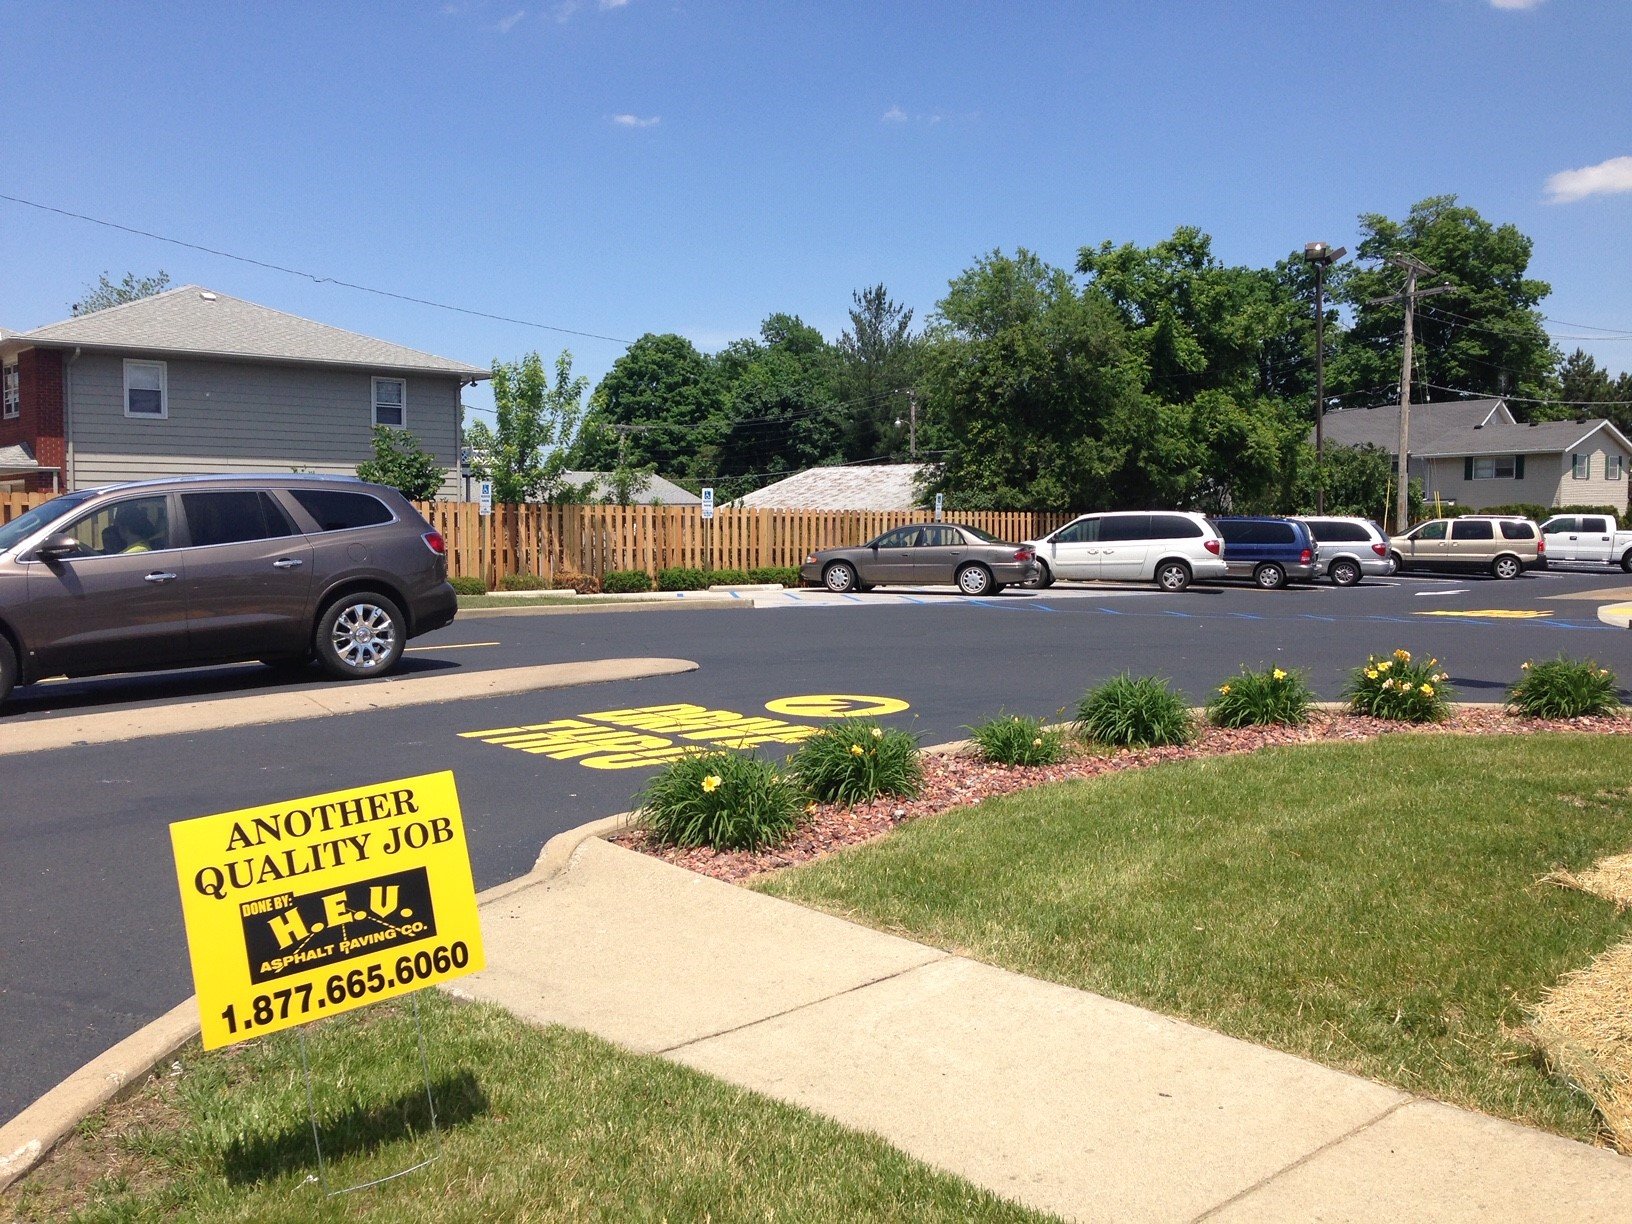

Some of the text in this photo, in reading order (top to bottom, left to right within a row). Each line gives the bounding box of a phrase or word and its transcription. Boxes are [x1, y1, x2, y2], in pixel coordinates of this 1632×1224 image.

[226, 789, 419, 851] ANOTHER
[194, 816, 454, 900] QUALITY JOB
[242, 893, 294, 917] DONE BY:
[260, 922, 428, 974] ASPHALT PAVING CO.
[222, 941, 469, 1034] 1.877.665.6060
